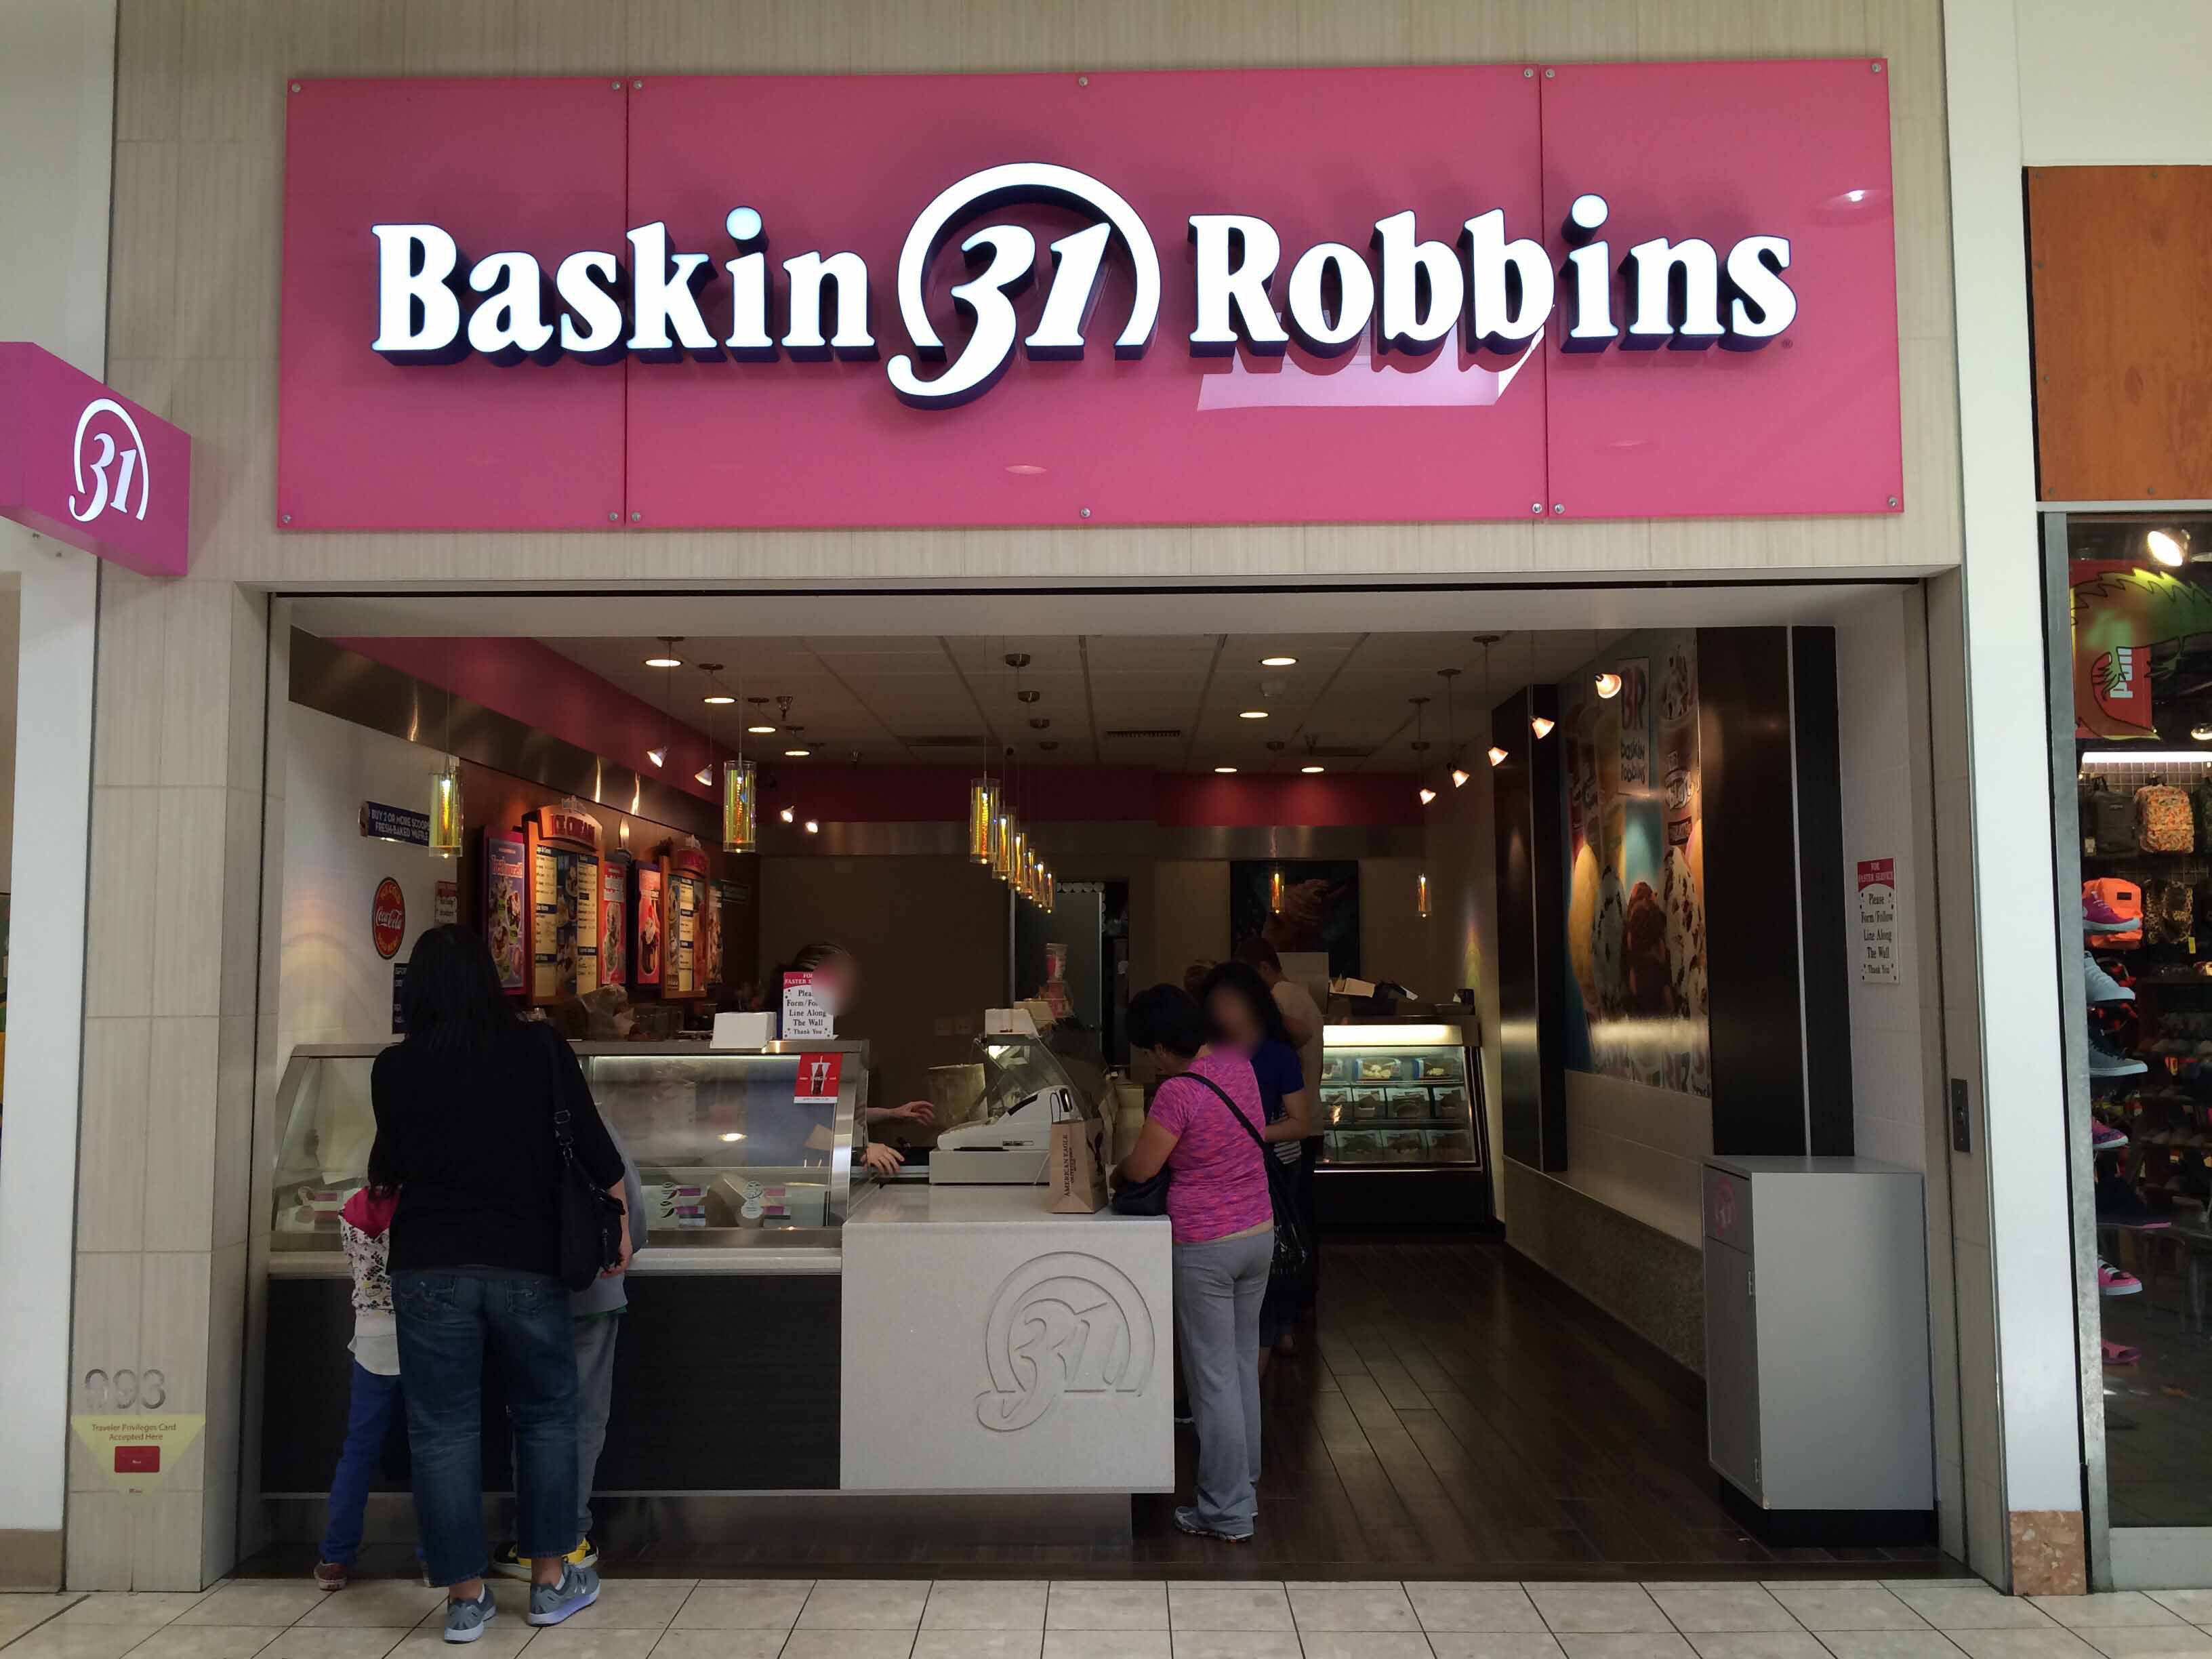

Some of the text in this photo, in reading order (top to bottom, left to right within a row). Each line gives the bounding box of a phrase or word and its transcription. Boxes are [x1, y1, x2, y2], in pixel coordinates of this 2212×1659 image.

[371, 194, 1797, 397] Baskin 31 Robbins
[68, 432, 138, 523] 31
[396, 815, 411, 826] MORE
[1868, 893, 1885, 905] Please
[376, 906, 403, 930] Coca-Cola
[1864, 928, 1892, 943] Line Along
[1867, 945, 1890, 959] The Wall
[1868, 964, 1890, 975] Thank You
[806, 1009, 827, 1017] Along
[122, 1423, 157, 1432] Privileges
[159, 1422, 176, 1431] Card
[108, 1433, 144, 1441] Accepted
